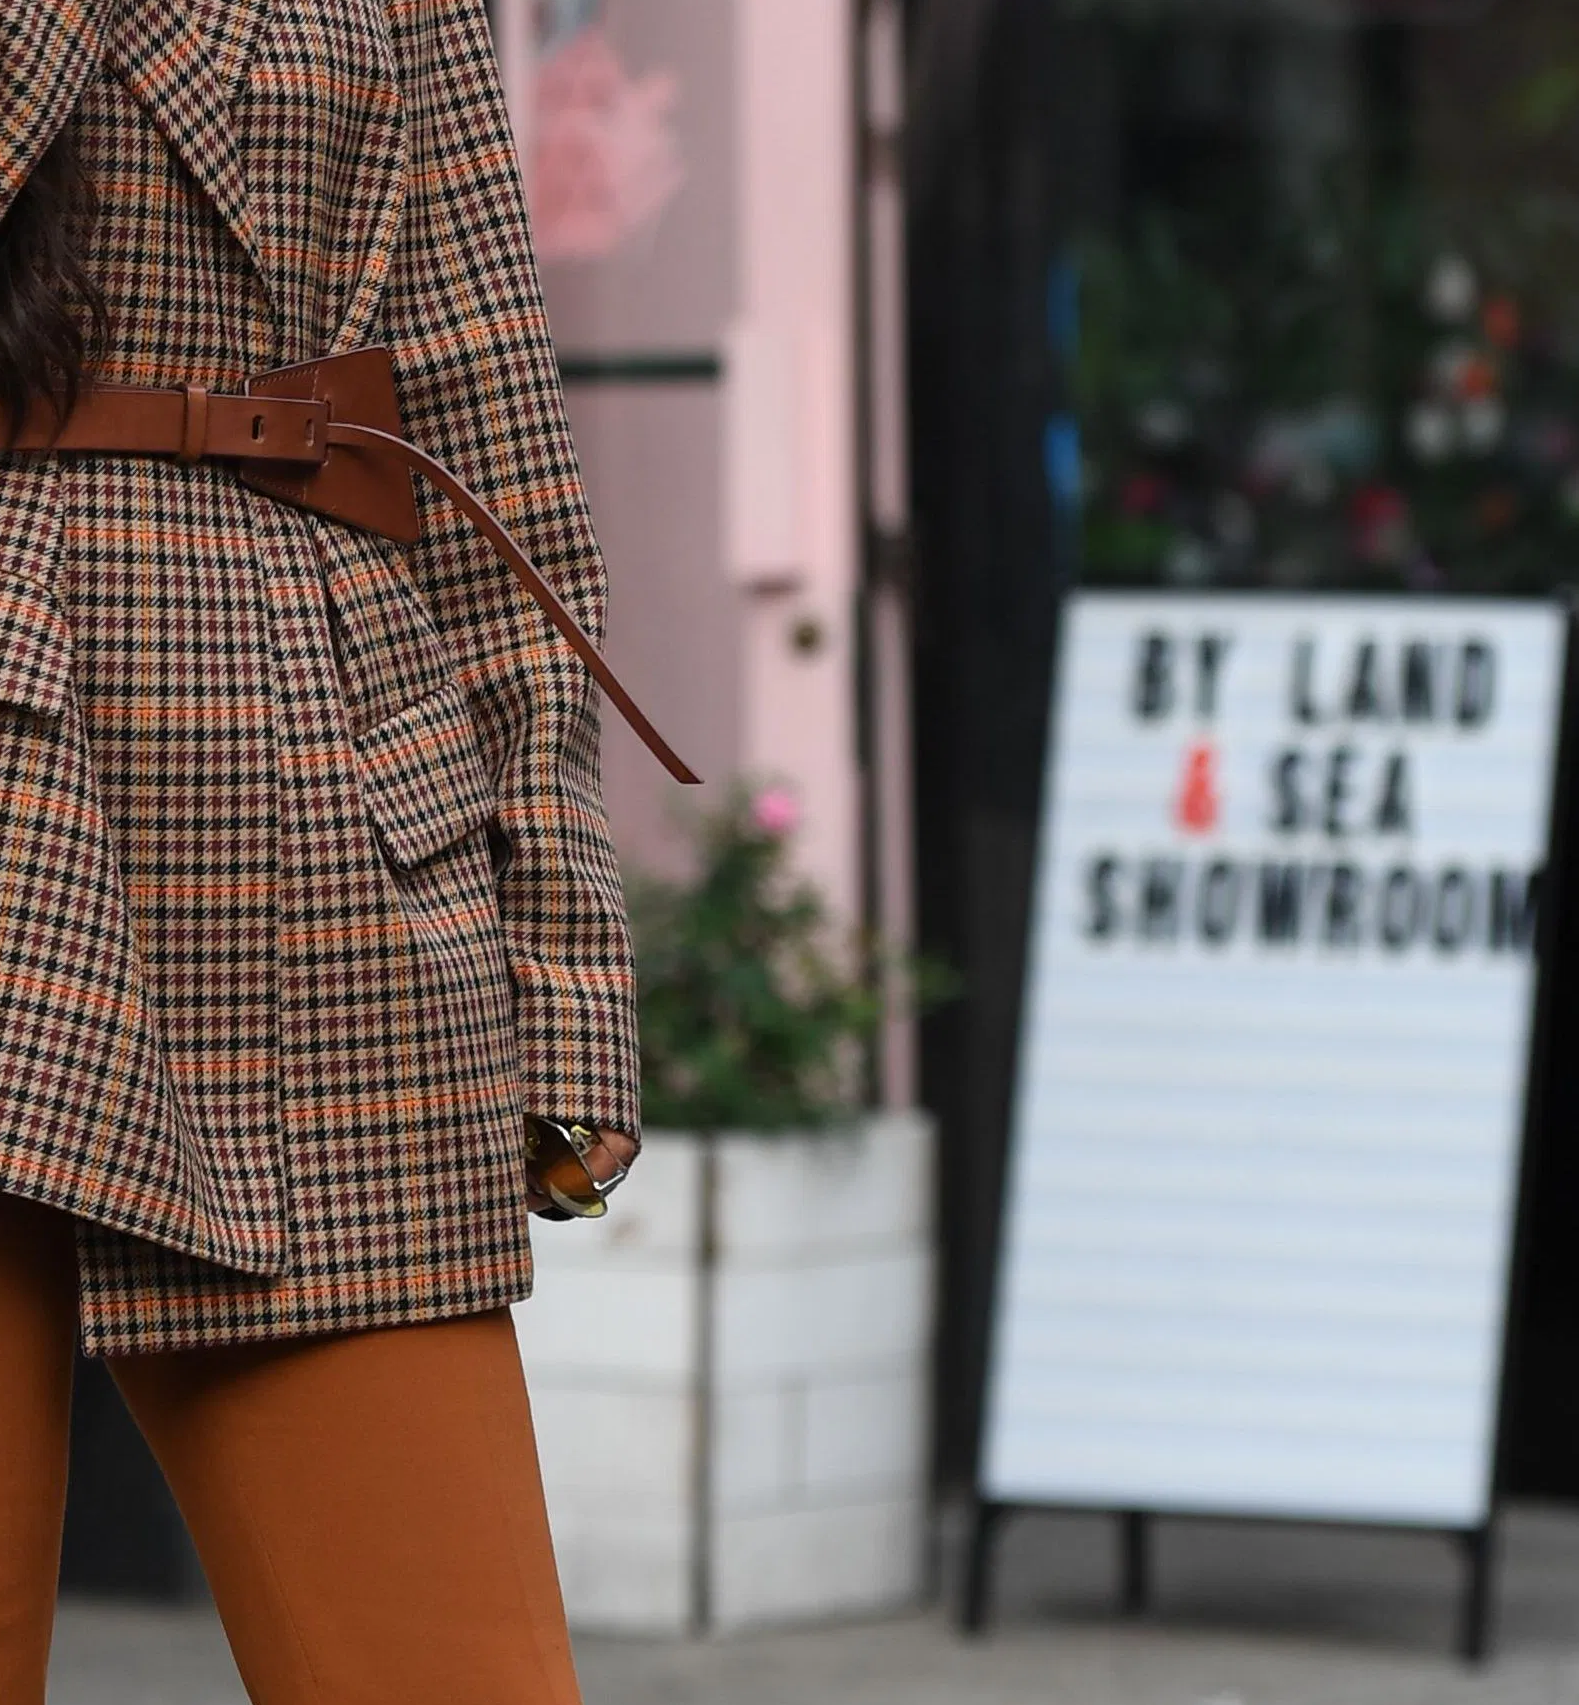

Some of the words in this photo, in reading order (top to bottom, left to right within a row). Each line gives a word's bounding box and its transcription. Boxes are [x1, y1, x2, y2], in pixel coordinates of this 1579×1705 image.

[1132, 630, 1231, 726] BY
[1292, 638, 1498, 728] LAND
[1272, 747, 1411, 838] SEA
[1084, 854, 1542, 953] SHOWROOM
